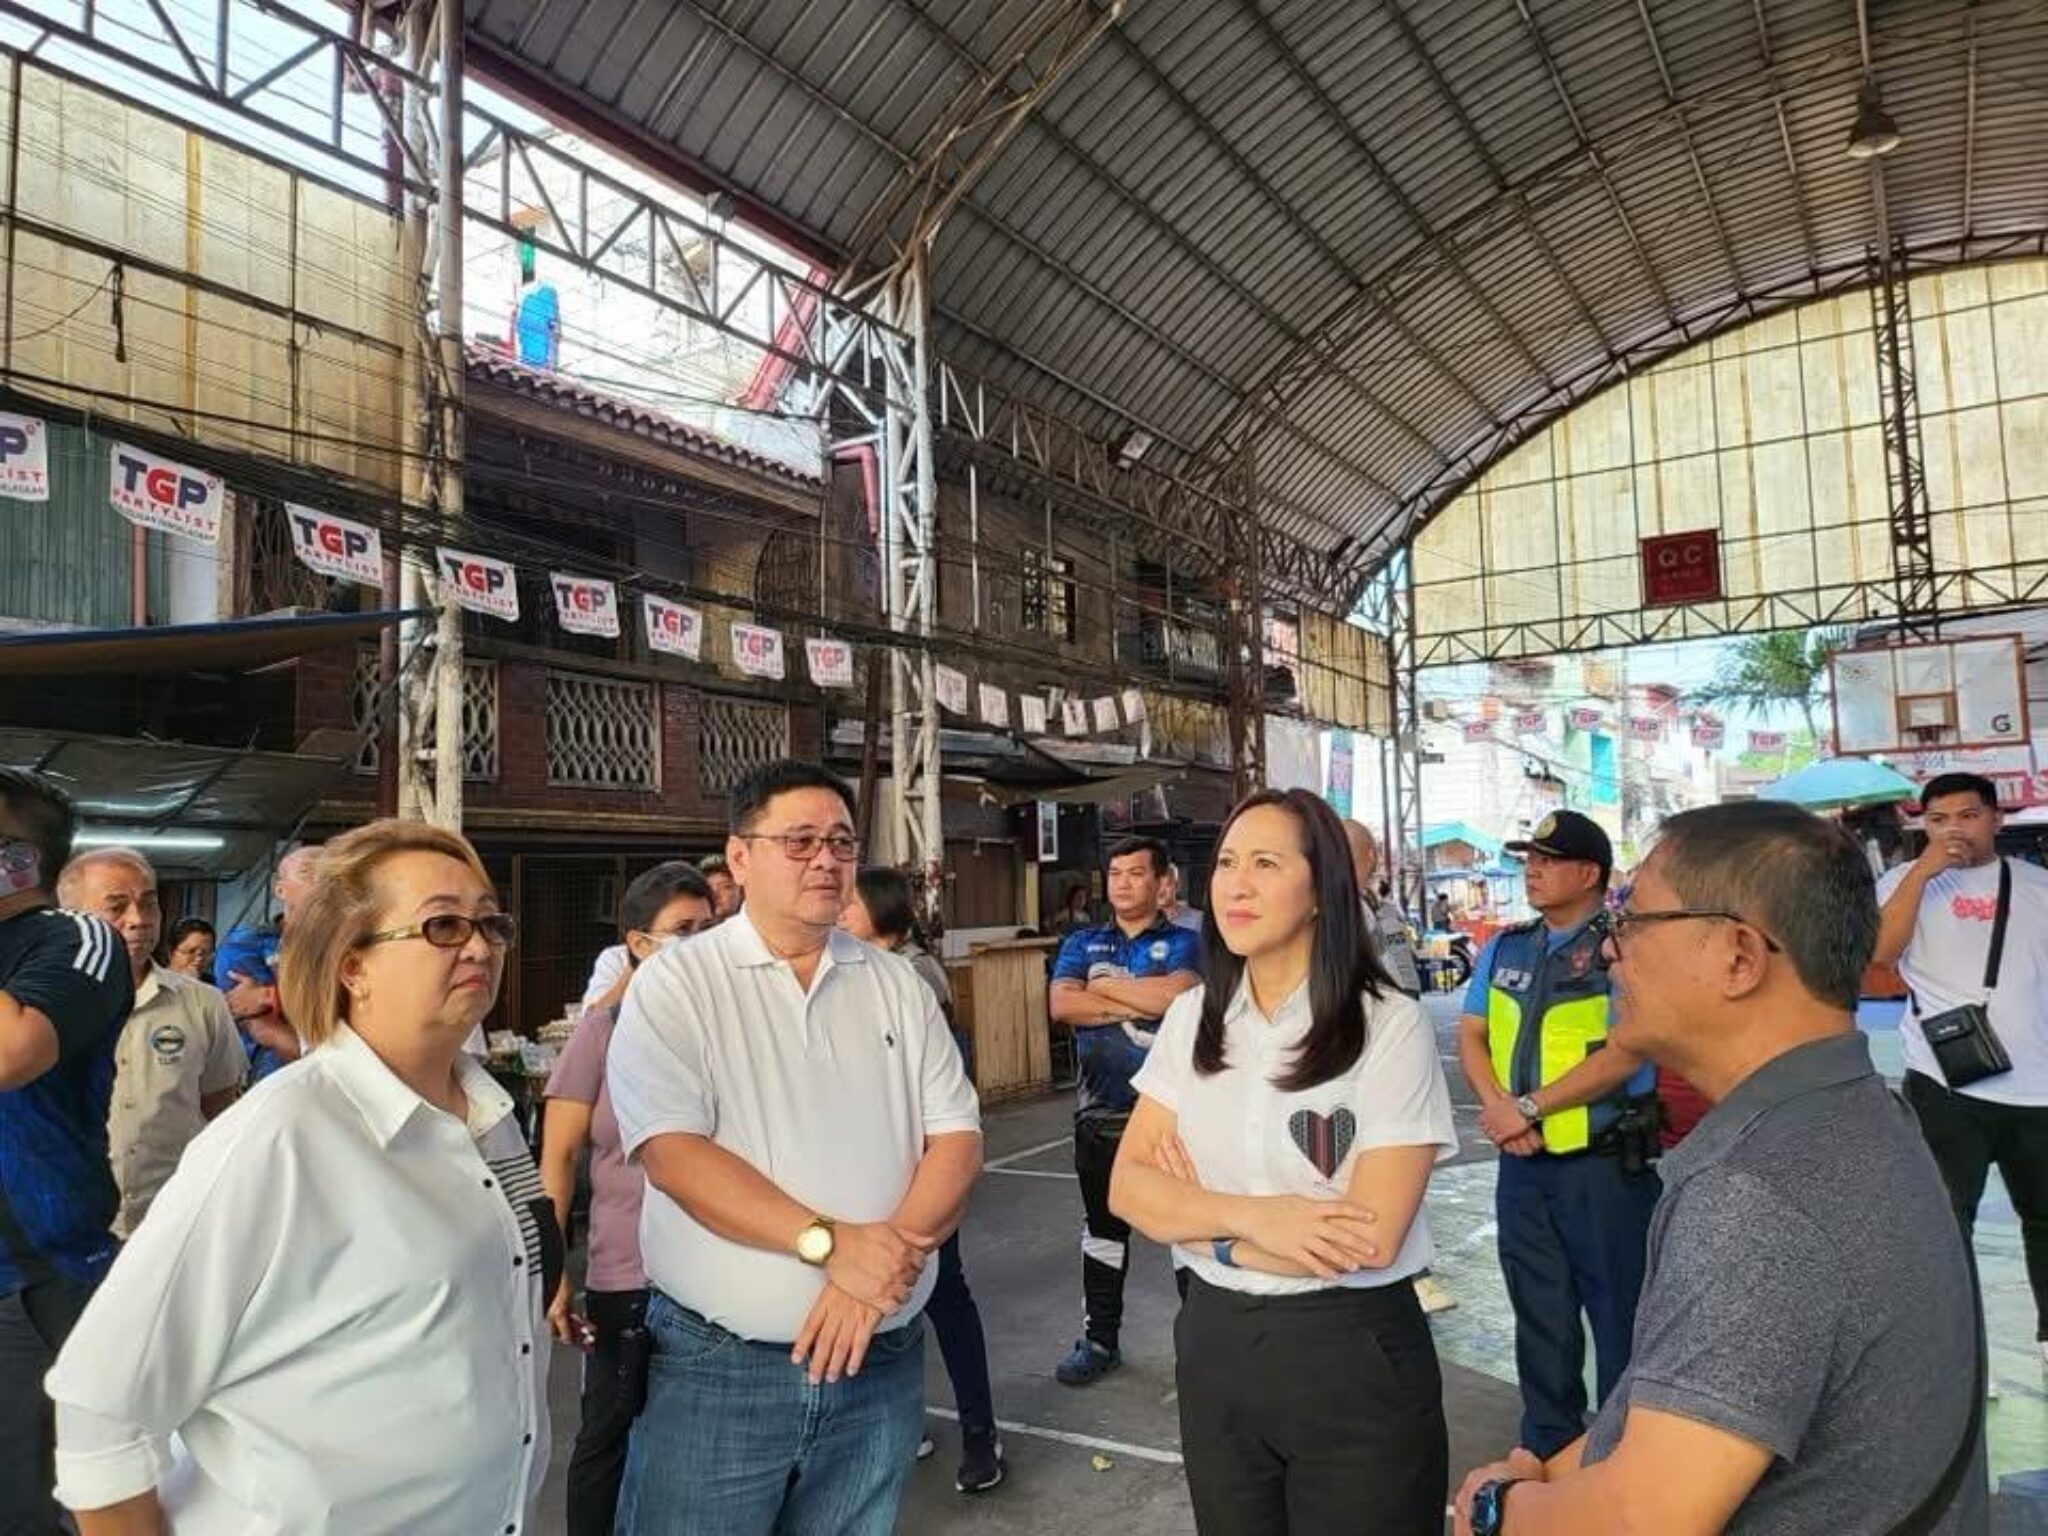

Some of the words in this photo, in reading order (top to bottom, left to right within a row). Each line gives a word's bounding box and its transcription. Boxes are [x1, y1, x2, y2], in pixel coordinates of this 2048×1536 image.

[119, 454, 208, 509] TGP
[112, 488, 215, 531] PARTYLIST
[292, 514, 368, 558] TGP
[443, 556, 504, 594] TGP
[556, 584, 606, 613] TGP
[649, 603, 693, 638] TGP
[1992, 714, 2012, 733] G
